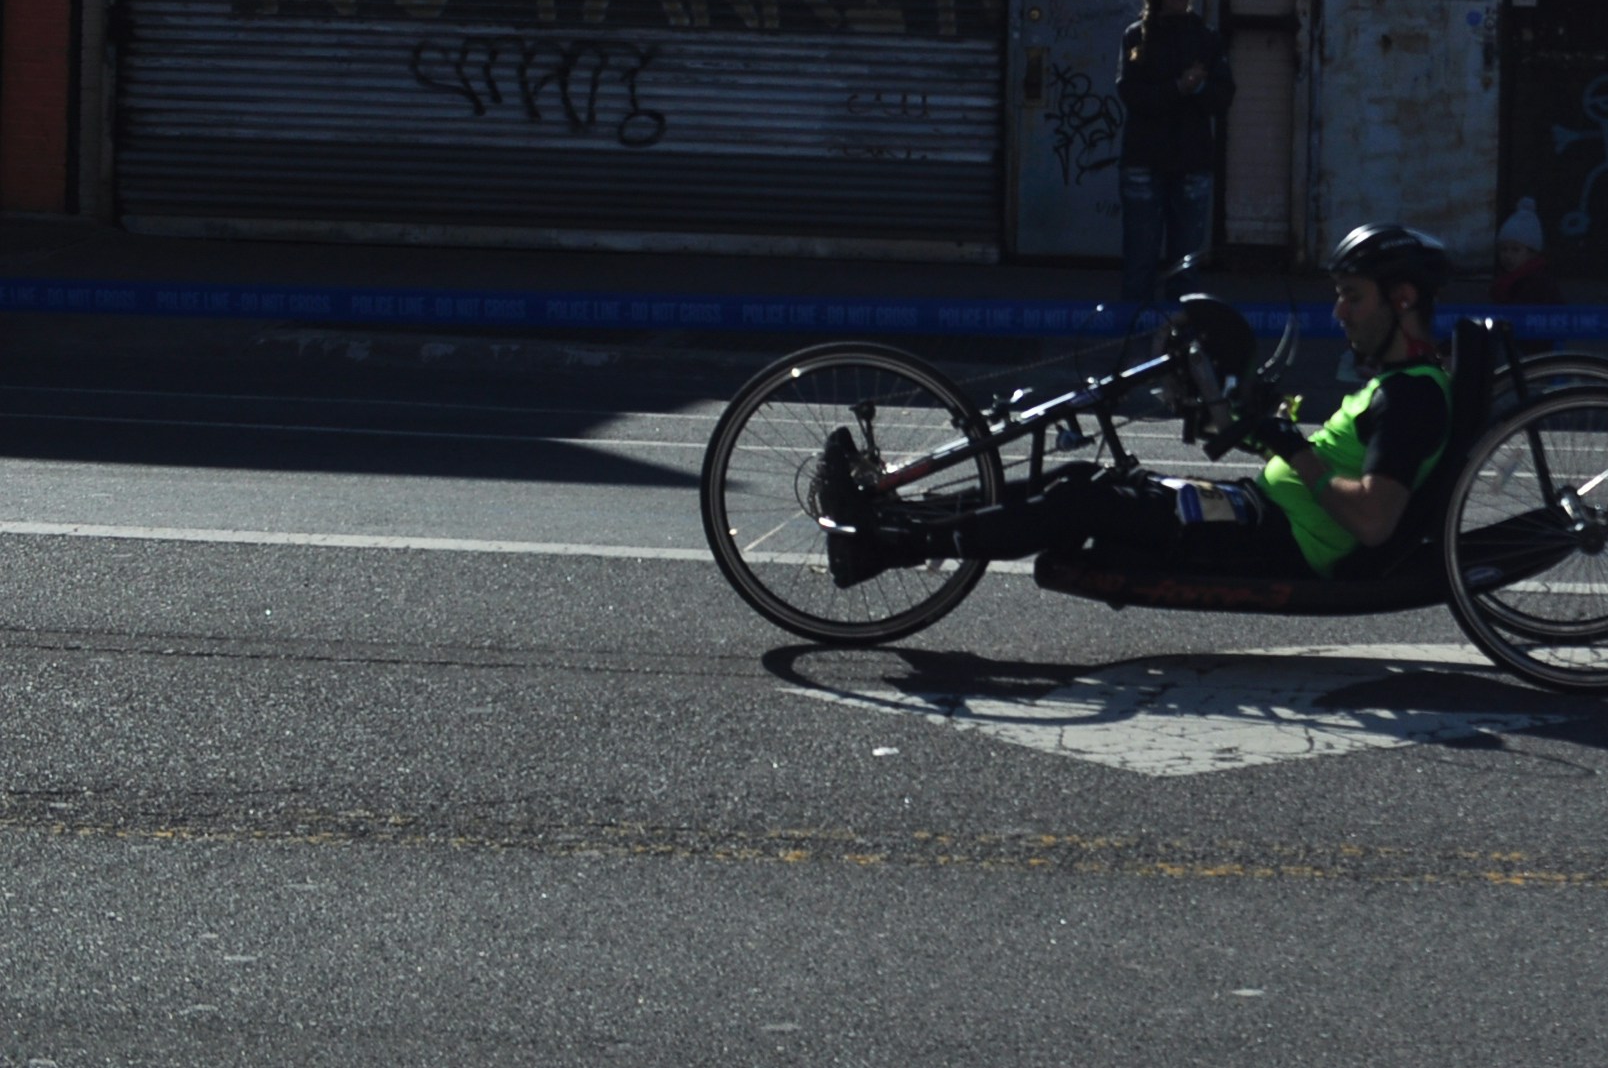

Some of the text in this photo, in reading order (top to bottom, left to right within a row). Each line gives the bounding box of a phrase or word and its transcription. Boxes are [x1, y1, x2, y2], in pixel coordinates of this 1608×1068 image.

[10, 287, 35, 307] LINE
[48, 288, 64, 308] DO
[67, 289, 91, 309] NOT
[95, 290, 135, 310] CROSS
[157, 291, 330, 314] POLICE LINE DO NOT CROSS
[351, 295, 525, 319] POLICE LINE DO NOT CROSS
[546, 299, 721, 323] POLICE LINE DO NOT CROSS
[742, 303, 918, 326] POLICE LINE DO NOT CROSS
[938, 306, 1113, 329] POLICE LINE DO NOT CROSS
